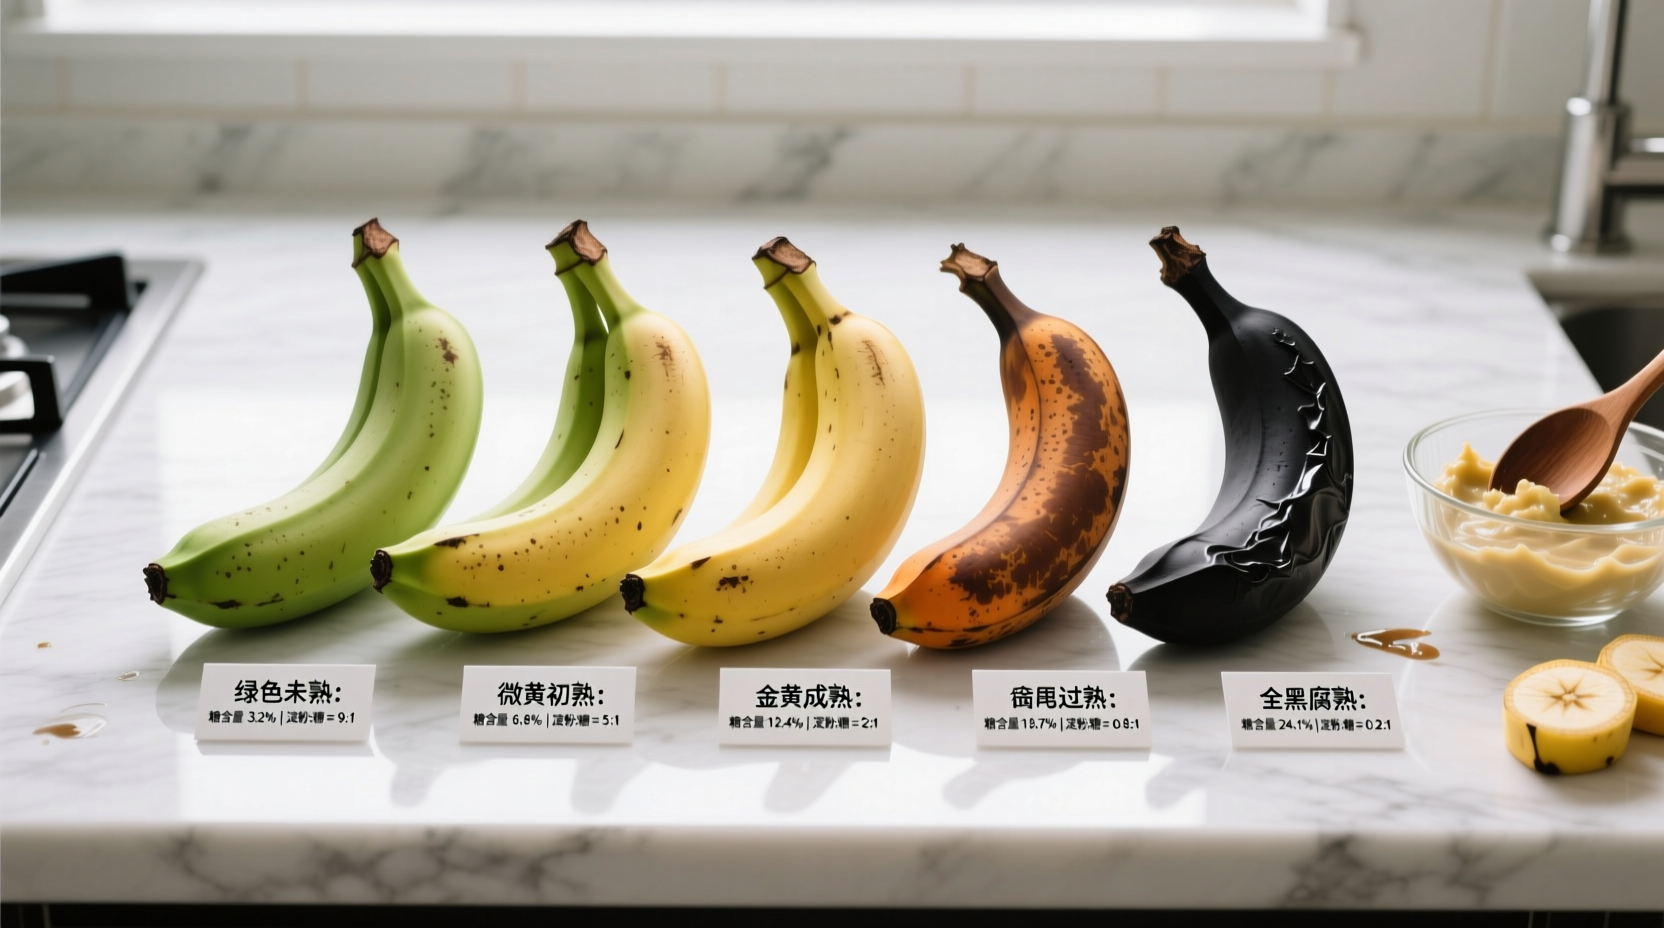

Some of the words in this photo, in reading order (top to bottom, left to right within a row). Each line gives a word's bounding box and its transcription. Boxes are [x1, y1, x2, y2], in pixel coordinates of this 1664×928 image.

[234, 679, 341, 704] 绿色未熟:
[497, 681, 603, 707] 微黄初熟:
[756, 683, 861, 709] 金黄成熟:
[1260, 686, 1366, 711] 全黑腐熟:
[338, 712, 354, 723] 9:1
[602, 715, 619, 726] 5:1
